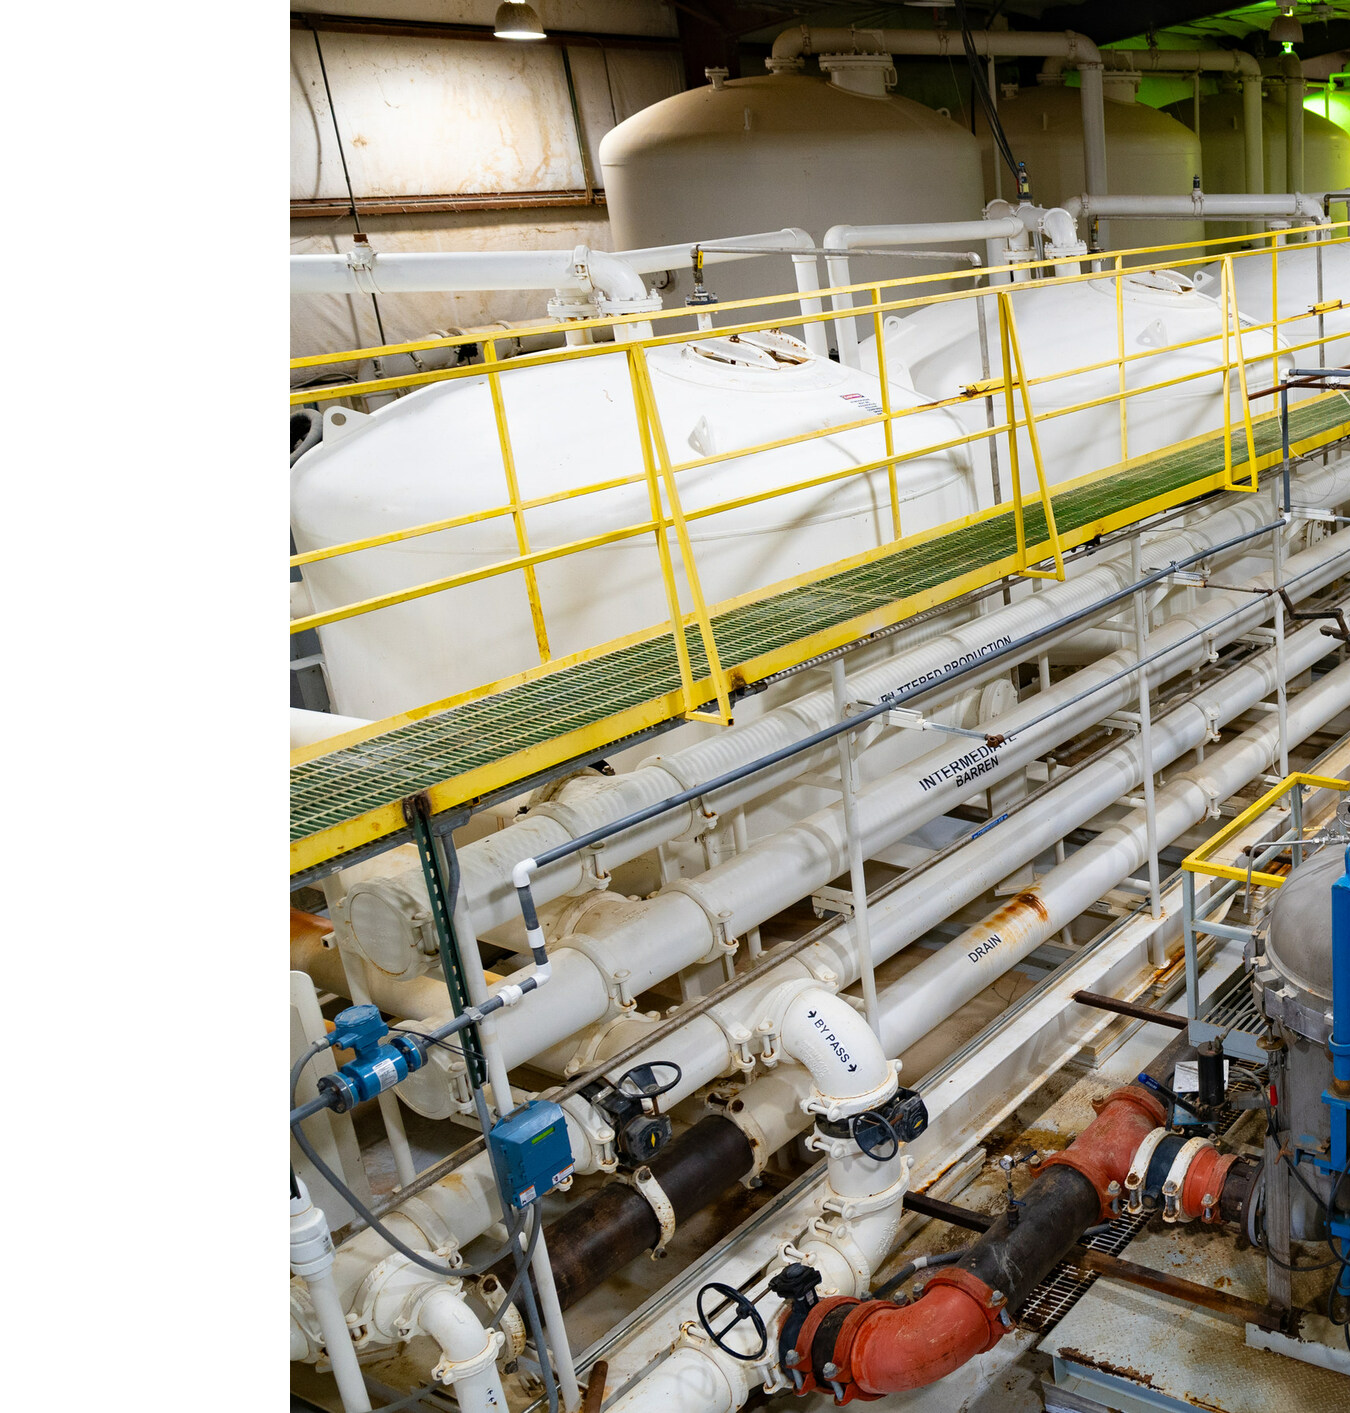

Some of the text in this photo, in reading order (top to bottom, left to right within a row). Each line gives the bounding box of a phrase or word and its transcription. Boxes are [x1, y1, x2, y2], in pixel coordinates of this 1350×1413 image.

[955, 754, 1000, 788] BARREN
[967, 934, 1002, 963] DRAIN
[814, 1018, 830, 1034] BY
[825, 1033, 850, 1063] PASS
